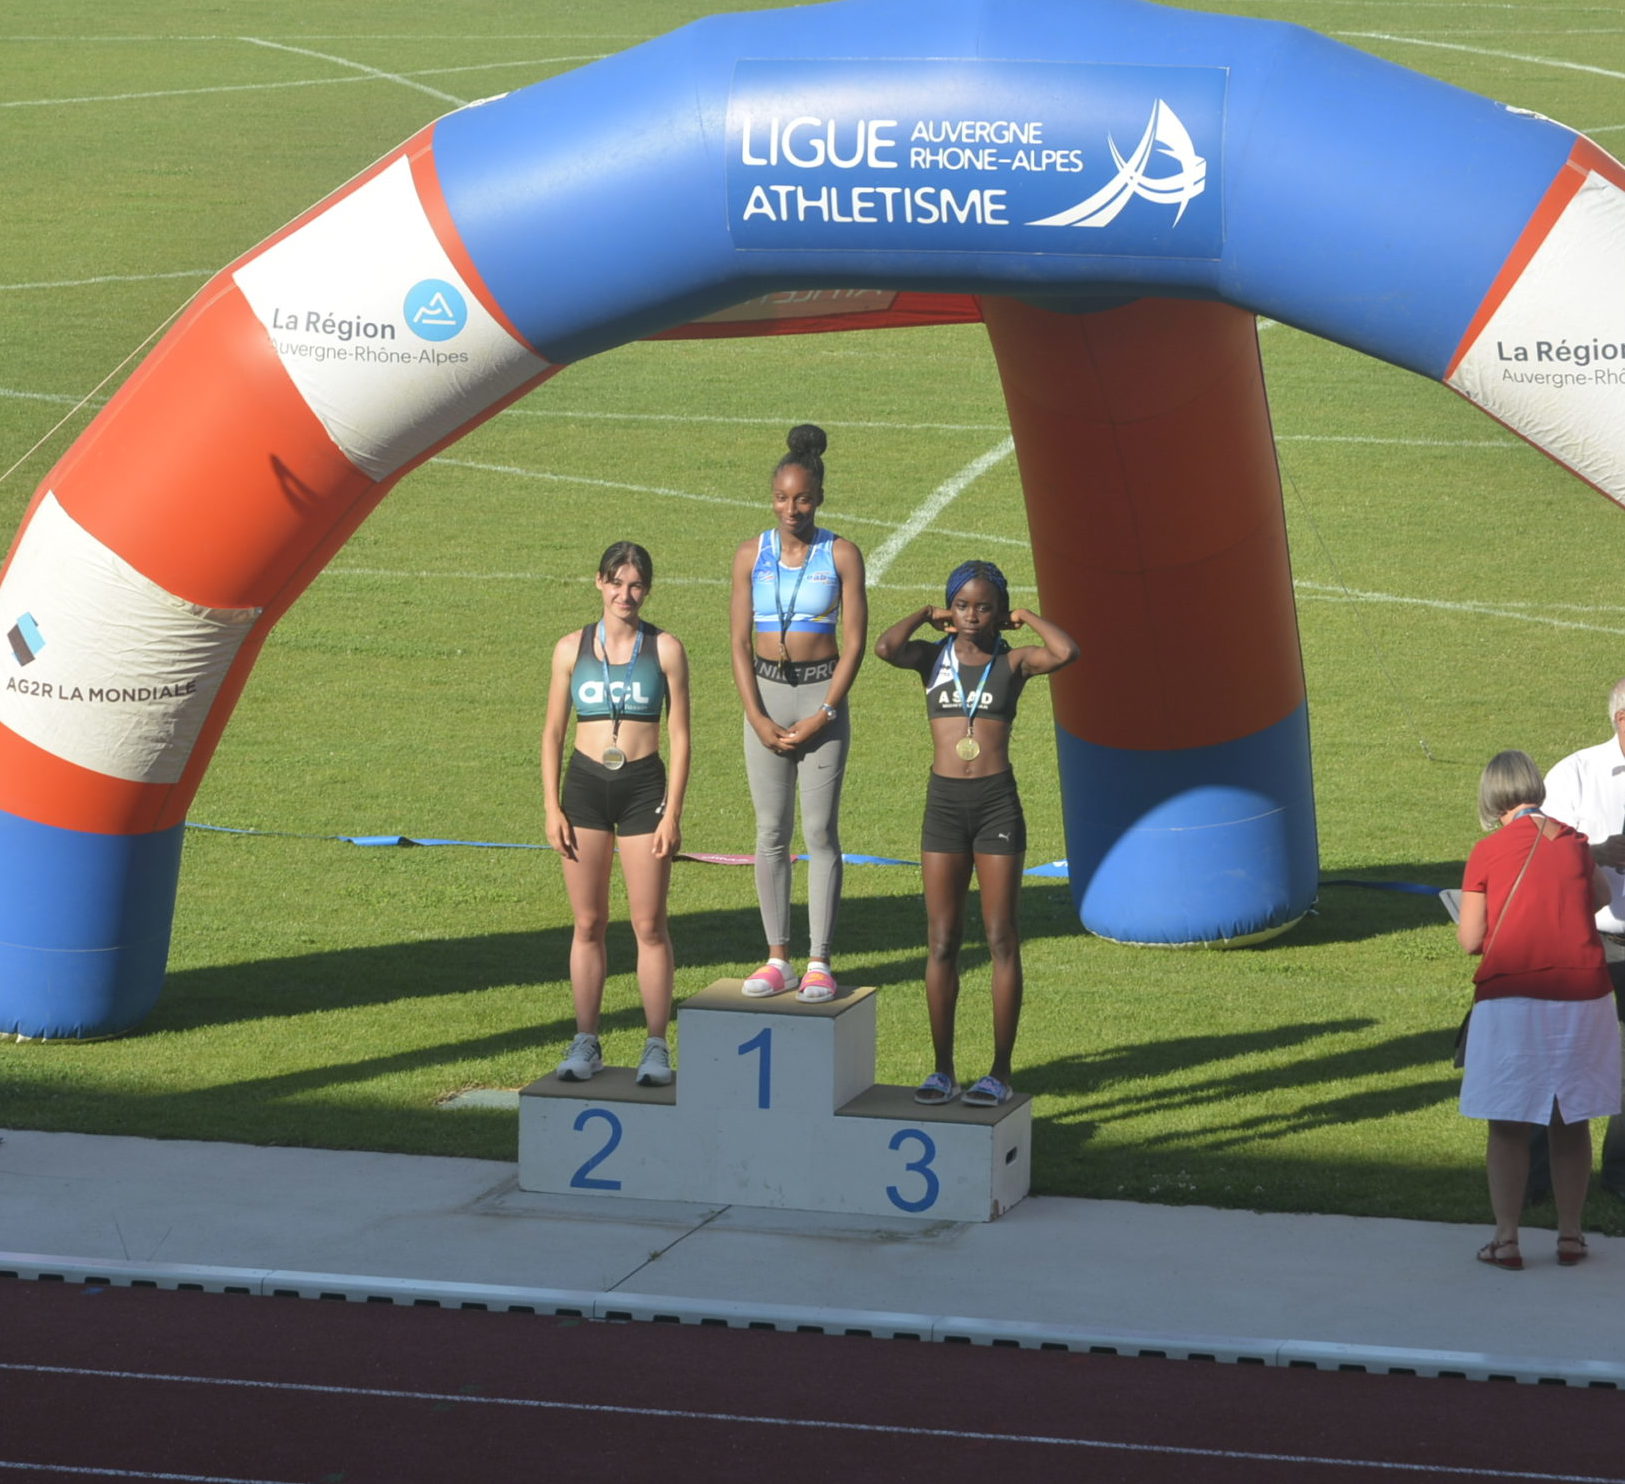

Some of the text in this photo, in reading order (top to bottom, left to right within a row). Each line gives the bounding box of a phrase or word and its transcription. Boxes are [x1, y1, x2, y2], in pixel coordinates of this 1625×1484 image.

[741, 116, 898, 170] LIGUE
[910, 120, 1043, 145] AUVERGNE
[910, 147, 1084, 173] RHONE-ALPES
[742, 184, 1010, 226] ATHLETISME
[272, 307, 396, 342] La Région
[1497, 340, 1529, 362] La
[6, 676, 198, 702] AG2R LA MONDIALE
[737, 1027, 772, 1110] 1
[569, 1107, 623, 1191] 2
[885, 1127, 940, 1213] 3
